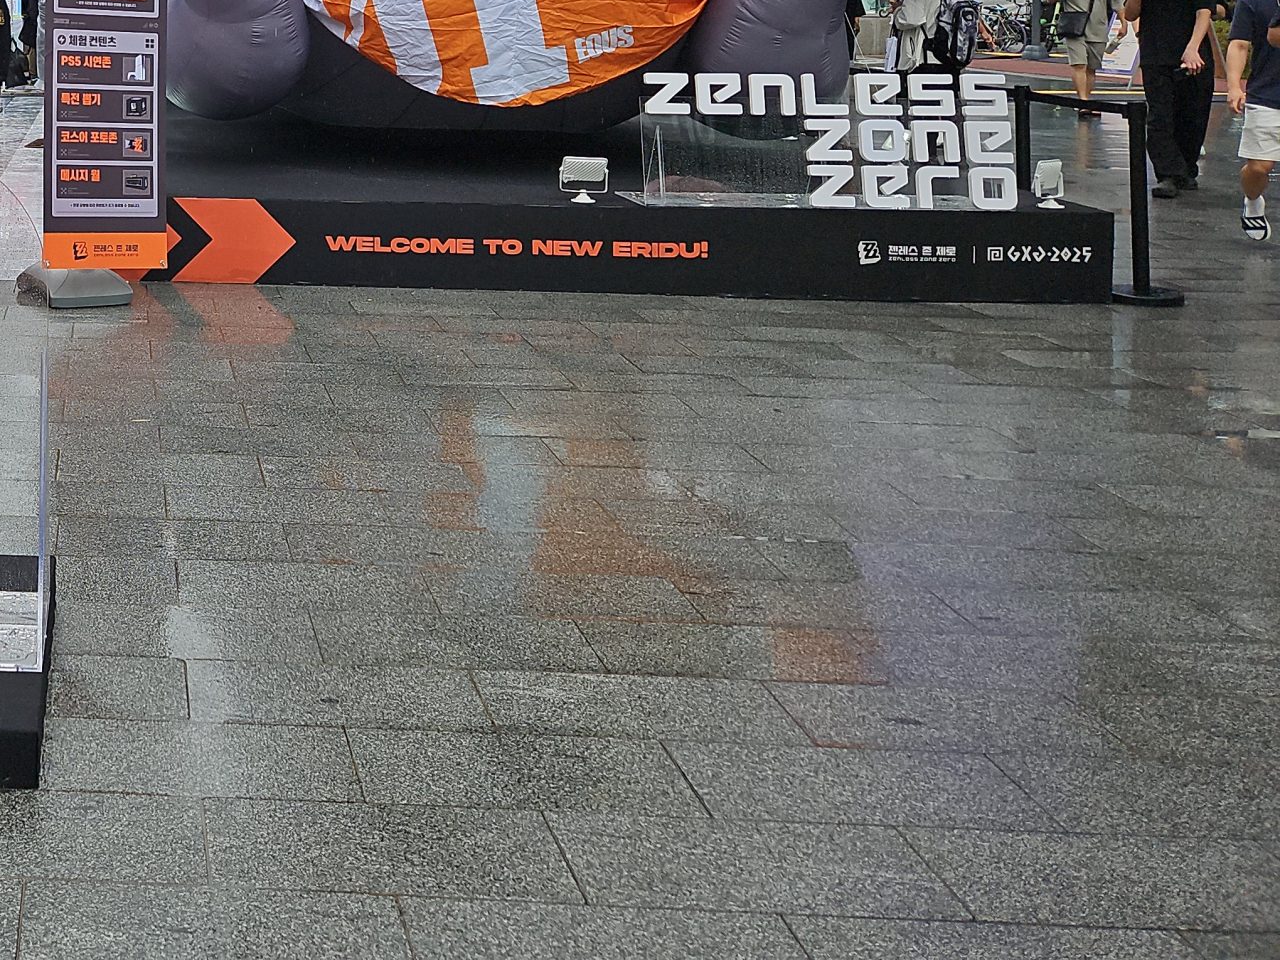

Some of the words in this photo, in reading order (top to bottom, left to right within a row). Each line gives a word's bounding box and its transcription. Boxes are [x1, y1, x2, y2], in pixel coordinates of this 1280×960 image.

[69, 35, 87, 47] 체험
[89, 36, 117, 48] 컨텐츠
[574, 25, 635, 65] EOUS
[61, 55, 81, 67] PS5
[83, 56, 112, 69] 시연존
[61, 93, 80, 106] 특전
[61, 131, 88, 143] 코스어
[90, 131, 118, 144] 포토존
[60, 169, 88, 181] 메시지
[325, 235, 474, 255] WELCOME
[483, 239, 523, 255] TO
[532, 240, 603, 257] NEW
[613, 241, 709, 259] ERIDU!
[888, 245, 918, 256] 젠레스
[922, 245, 932, 256] 존
[935, 246, 956, 256] 제로
